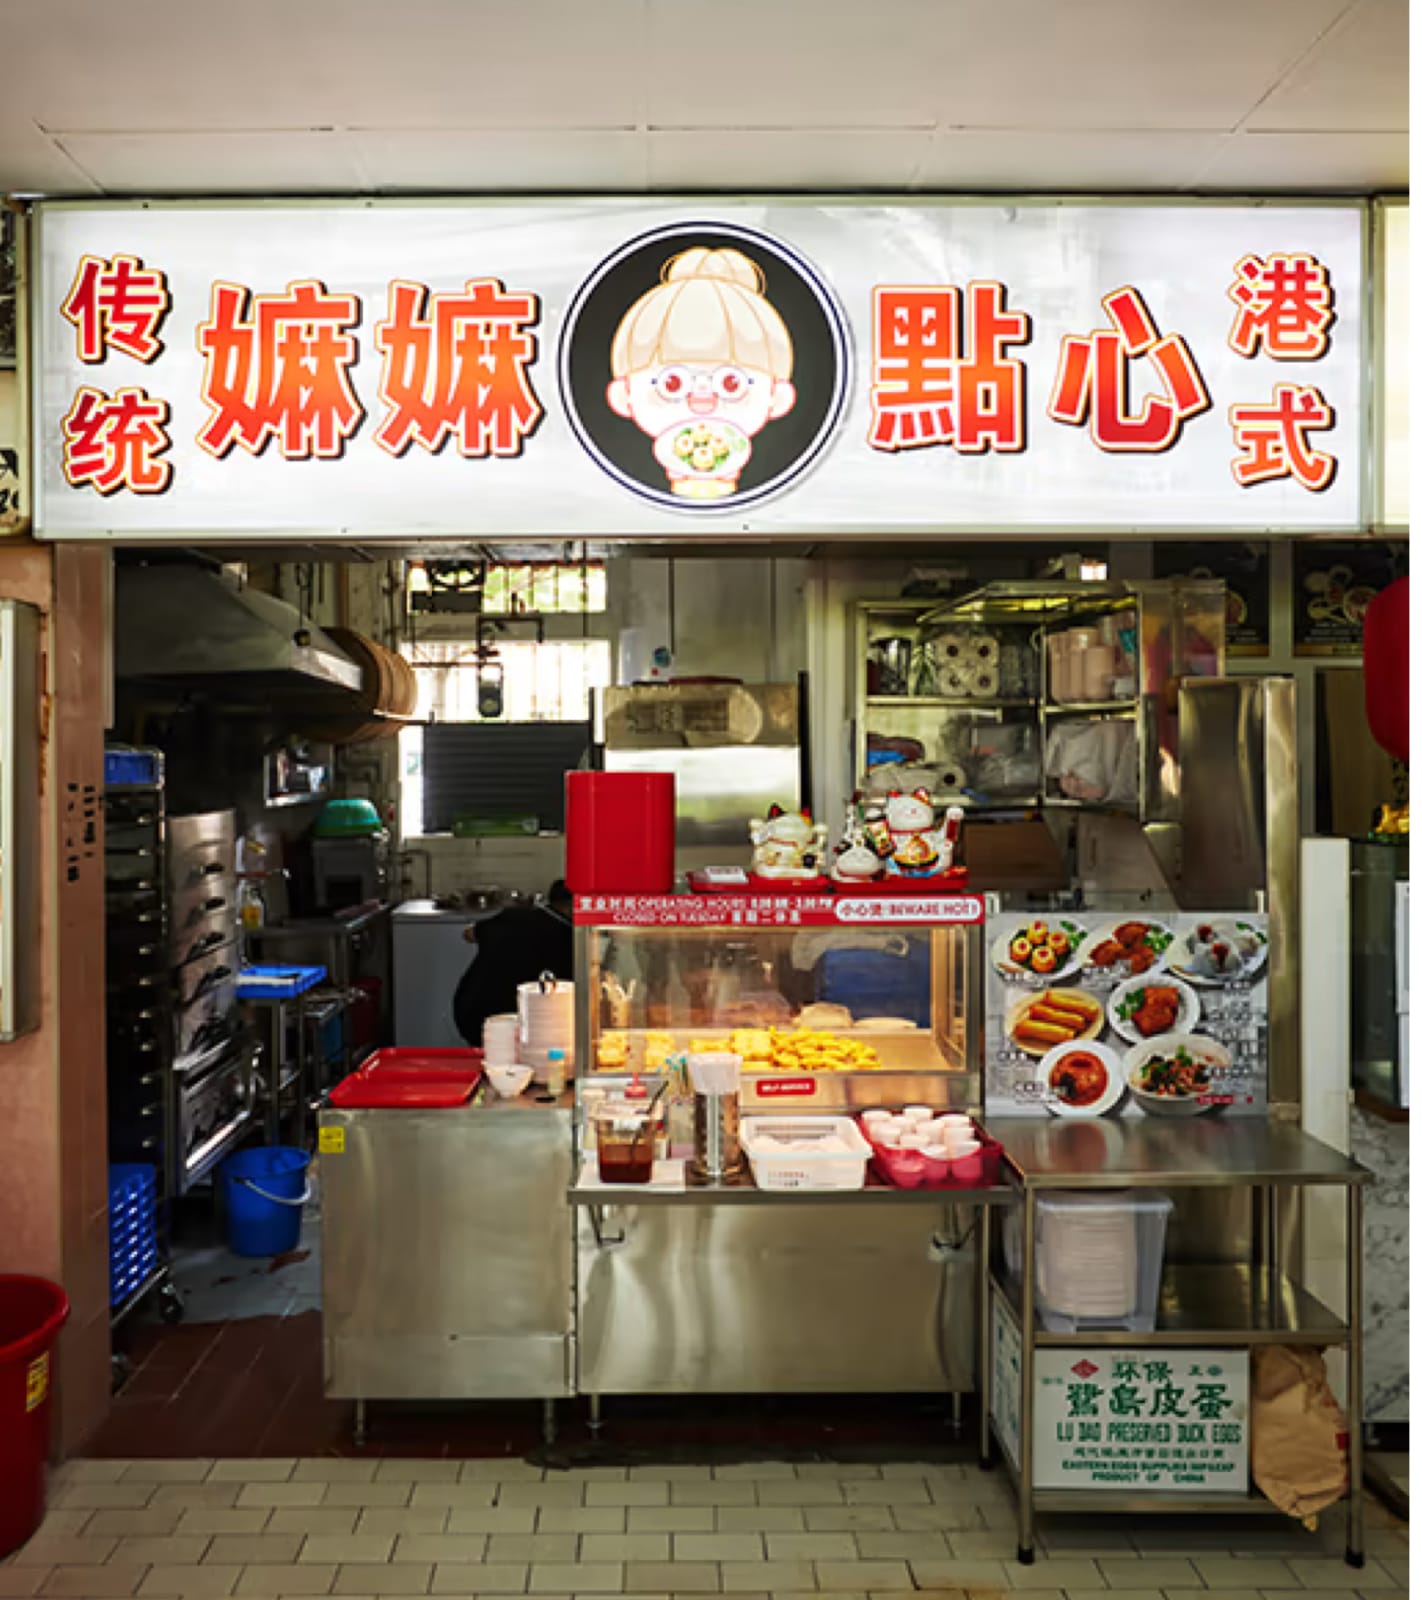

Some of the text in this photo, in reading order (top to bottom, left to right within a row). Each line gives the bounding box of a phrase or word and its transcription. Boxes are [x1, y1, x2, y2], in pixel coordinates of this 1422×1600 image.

[62, 254, 172, 495] 传统
[197, 278, 545, 460] 嫲嫲
[867, 281, 1213, 455] 點心
[1228, 252, 1337, 492] 港式
[613, 911, 726, 923] CLOSED ON TUESDAY
[637, 896, 703, 911] OPERATING
[707, 896, 747, 910] HOURS
[1056, 1422, 1242, 1444] LU DAO PRESERVED DUCK EGGS
[1092, 1472, 1205, 1483] PRODUCT OF CHINA
